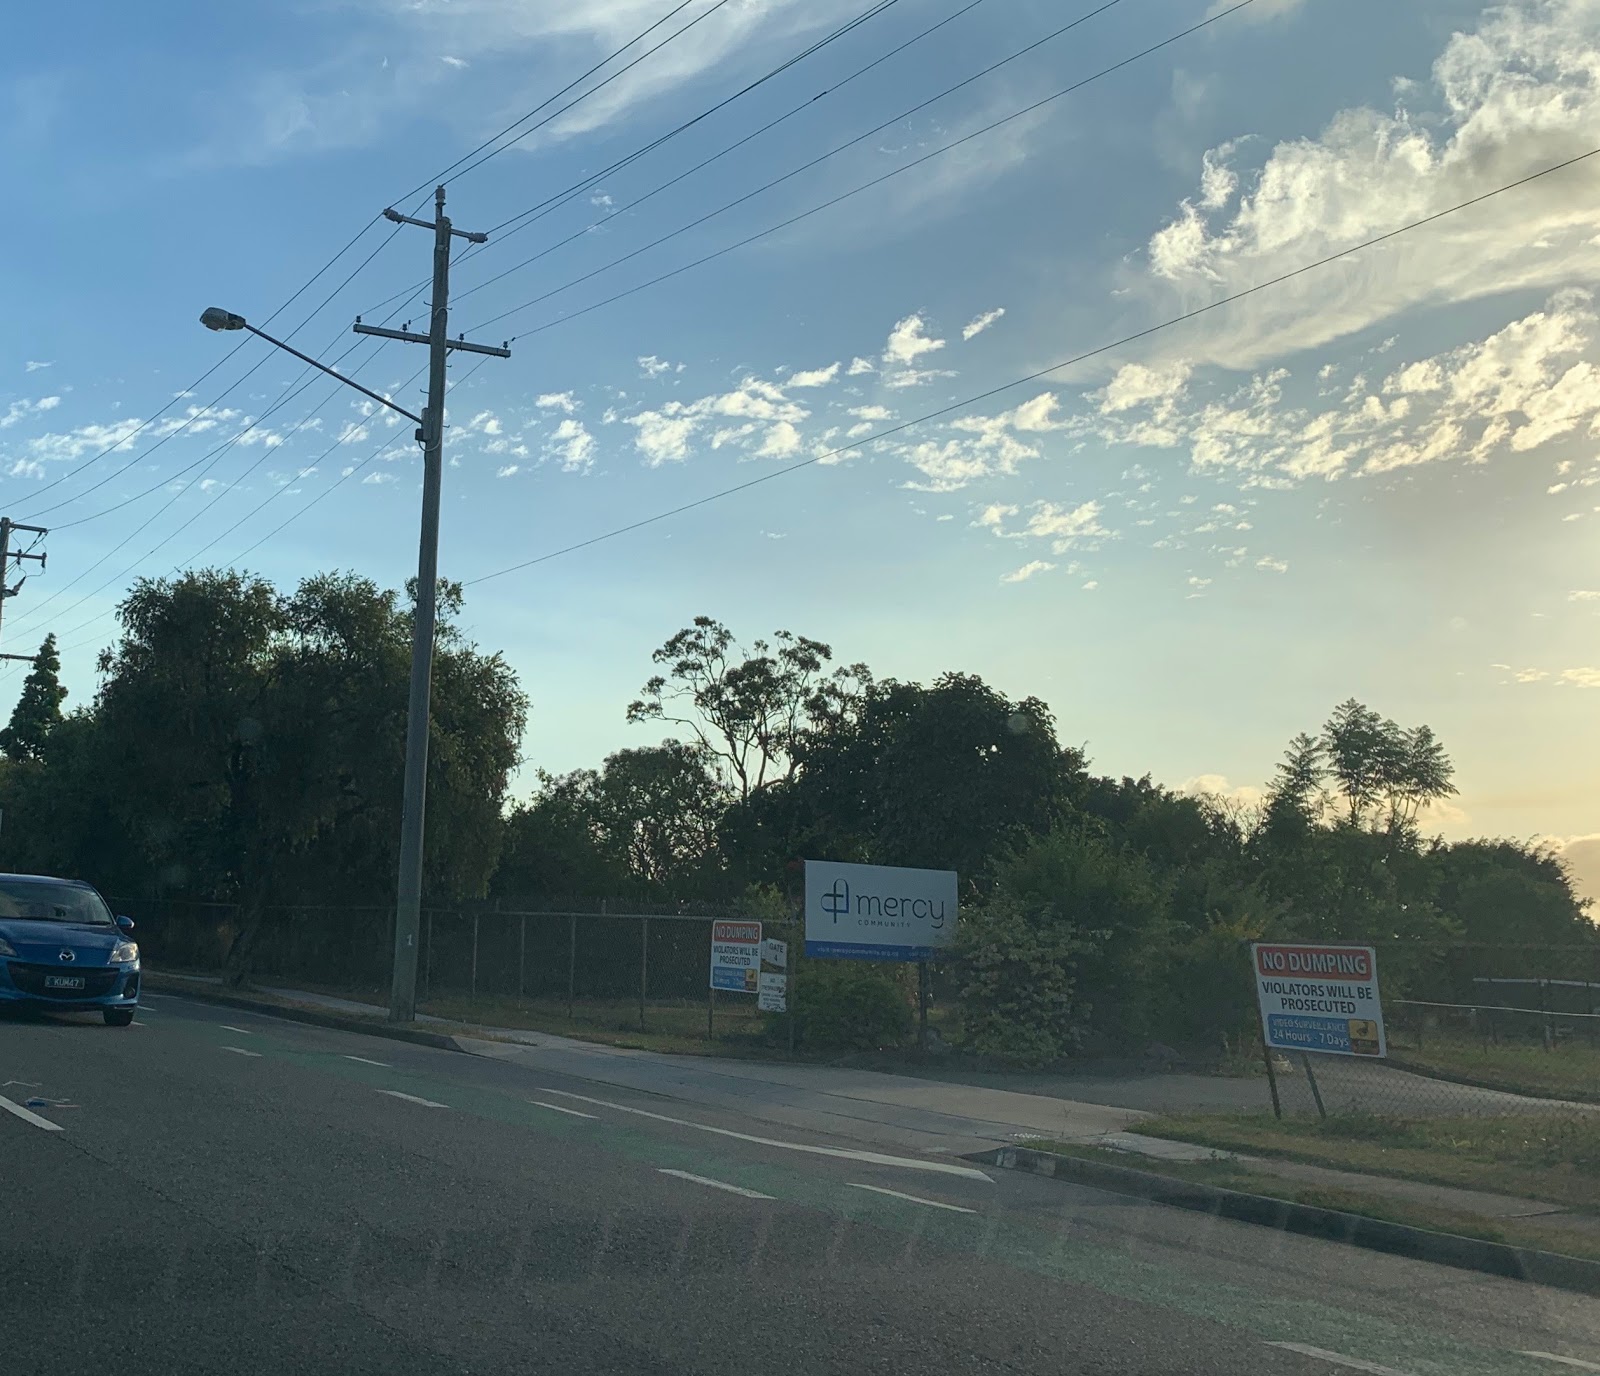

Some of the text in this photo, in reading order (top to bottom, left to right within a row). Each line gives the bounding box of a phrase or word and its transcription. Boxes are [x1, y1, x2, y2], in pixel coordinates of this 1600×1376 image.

[856, 894, 944, 929] mercy
[858, 919, 911, 928] COMMUNITY
[406, 934, 413, 946] 1
[716, 925, 758, 940] NO DUMPING
[713, 945, 758, 956] VIOLATORS WILL BE
[769, 943, 784, 953] GATE
[719, 955, 751, 966] PROSECUTED
[1261, 951, 1368, 975] NO DUMPING
[1261, 981, 1374, 1000] VIOLATORS WILL BE
[1281, 997, 1357, 1014] PROSECUTED
[1273, 1028, 1284, 1040] 24
[1285, 1030, 1311, 1042] Hours
[1319, 1032, 1325, 1044] 7
[1327, 1034, 1350, 1048] Days
